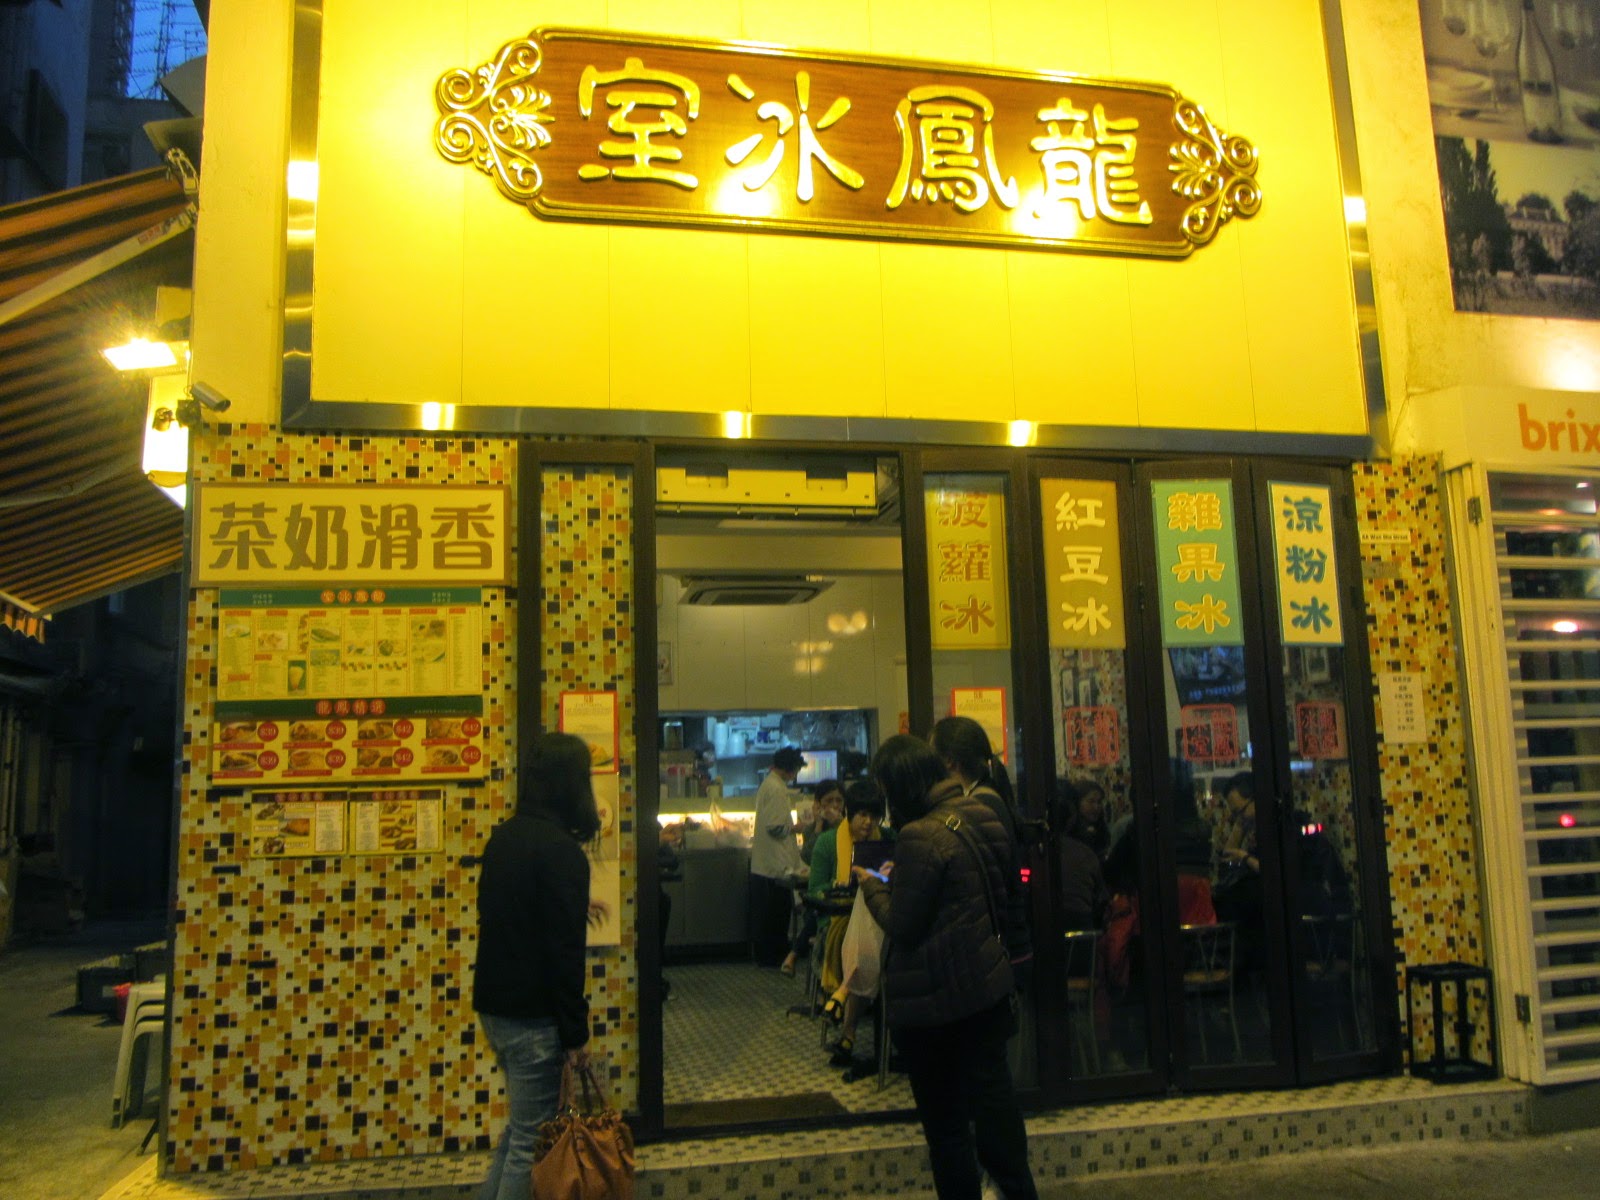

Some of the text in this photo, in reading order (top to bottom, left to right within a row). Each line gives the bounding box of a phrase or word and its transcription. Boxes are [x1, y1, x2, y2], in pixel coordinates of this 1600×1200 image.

[1055, 491, 1112, 636] 紅豆冰
[1282, 494, 1334, 634] 涼粉冰
